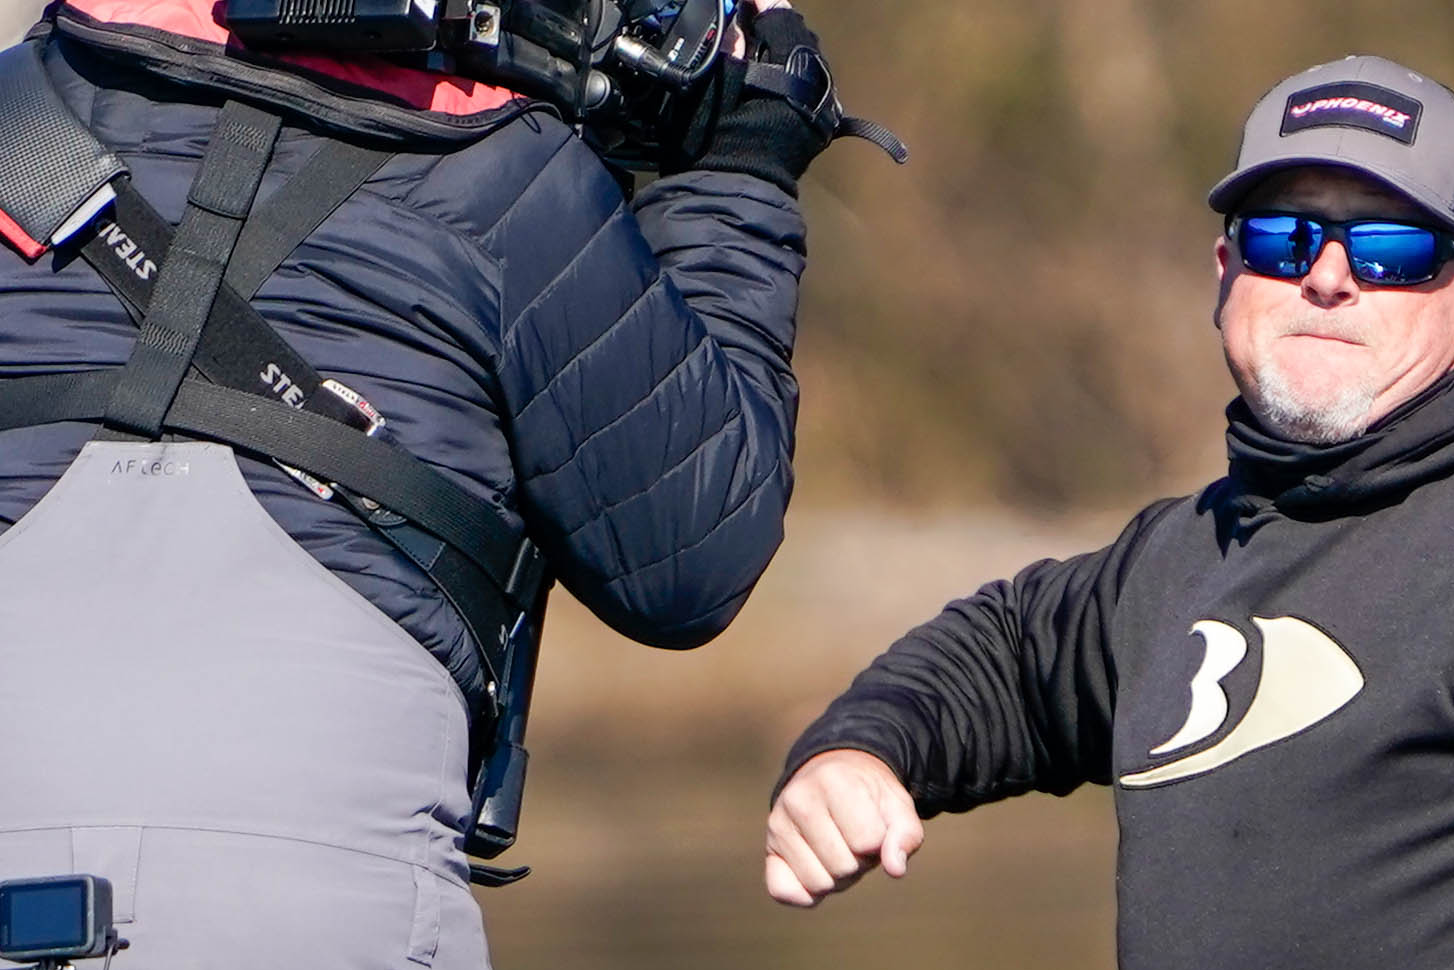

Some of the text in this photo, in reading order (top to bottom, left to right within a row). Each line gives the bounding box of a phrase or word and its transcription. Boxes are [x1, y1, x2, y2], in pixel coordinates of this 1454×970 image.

[1309, 97, 1411, 121] PHOENIX
[98, 222, 158, 280] STEA
[260, 362, 306, 410] STE
